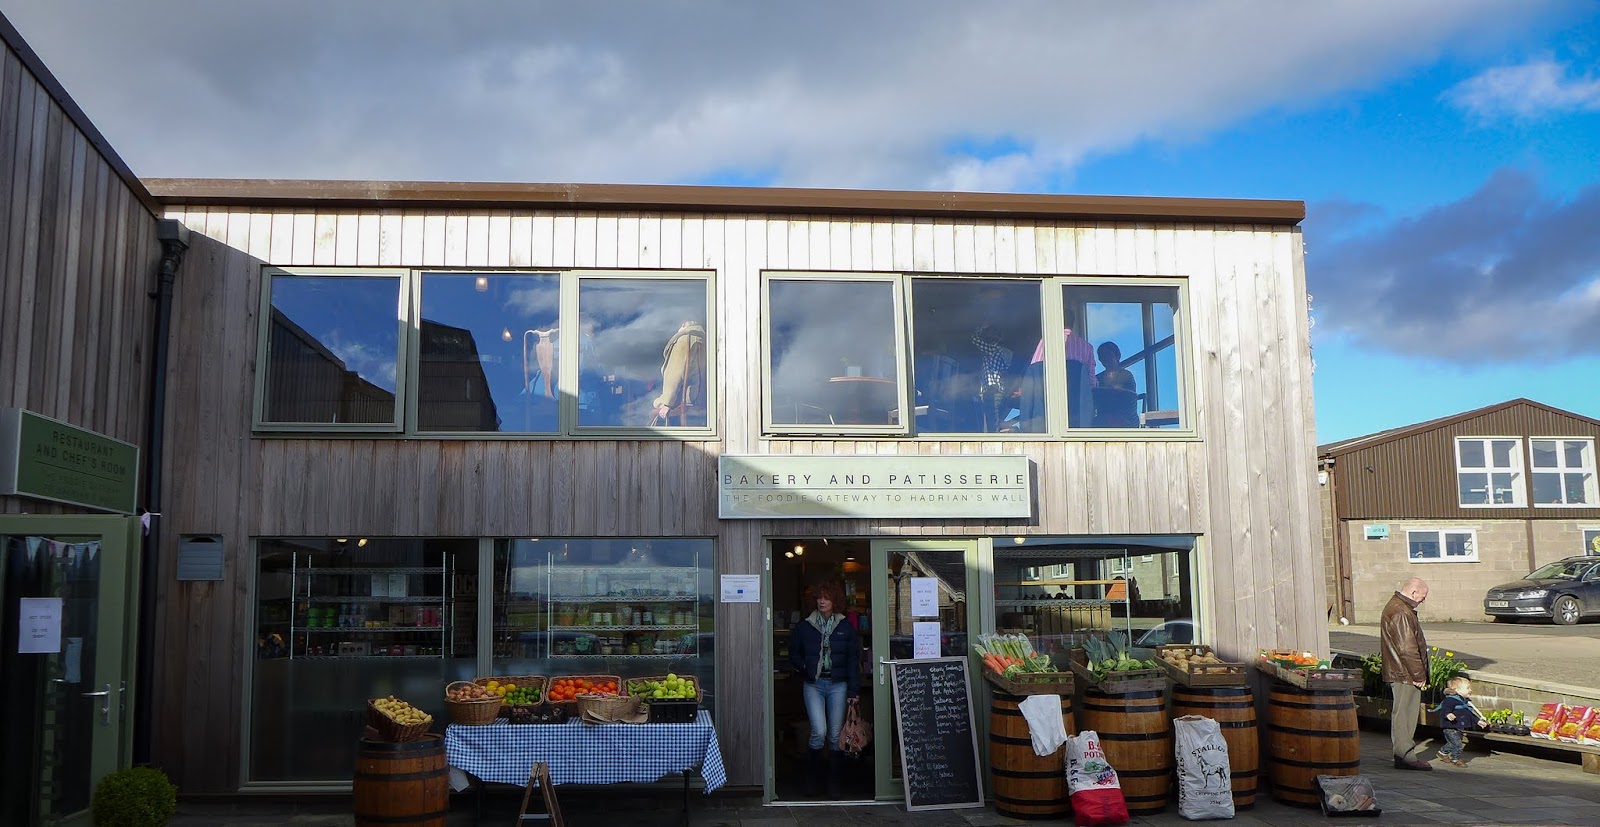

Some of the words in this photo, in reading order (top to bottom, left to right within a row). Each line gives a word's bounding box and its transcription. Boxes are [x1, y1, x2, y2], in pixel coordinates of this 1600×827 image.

[53, 431, 114, 457] RESTAURANT
[35, 444, 57, 458] AND
[62, 451, 97, 469] CHEF'S
[101, 461, 126, 476] ROOM
[724, 474, 812, 485] BAKERY
[829, 474, 871, 485] AND
[889, 474, 1024, 485] PATISSERIE
[725, 494, 749, 502] THE
[758, 494, 808, 502] FOODIE
[816, 494, 877, 502] GATEWAY
[886, 494, 902, 502] TO
[910, 494, 983, 502] HADRIAN'S
[991, 494, 1024, 502] WALL
